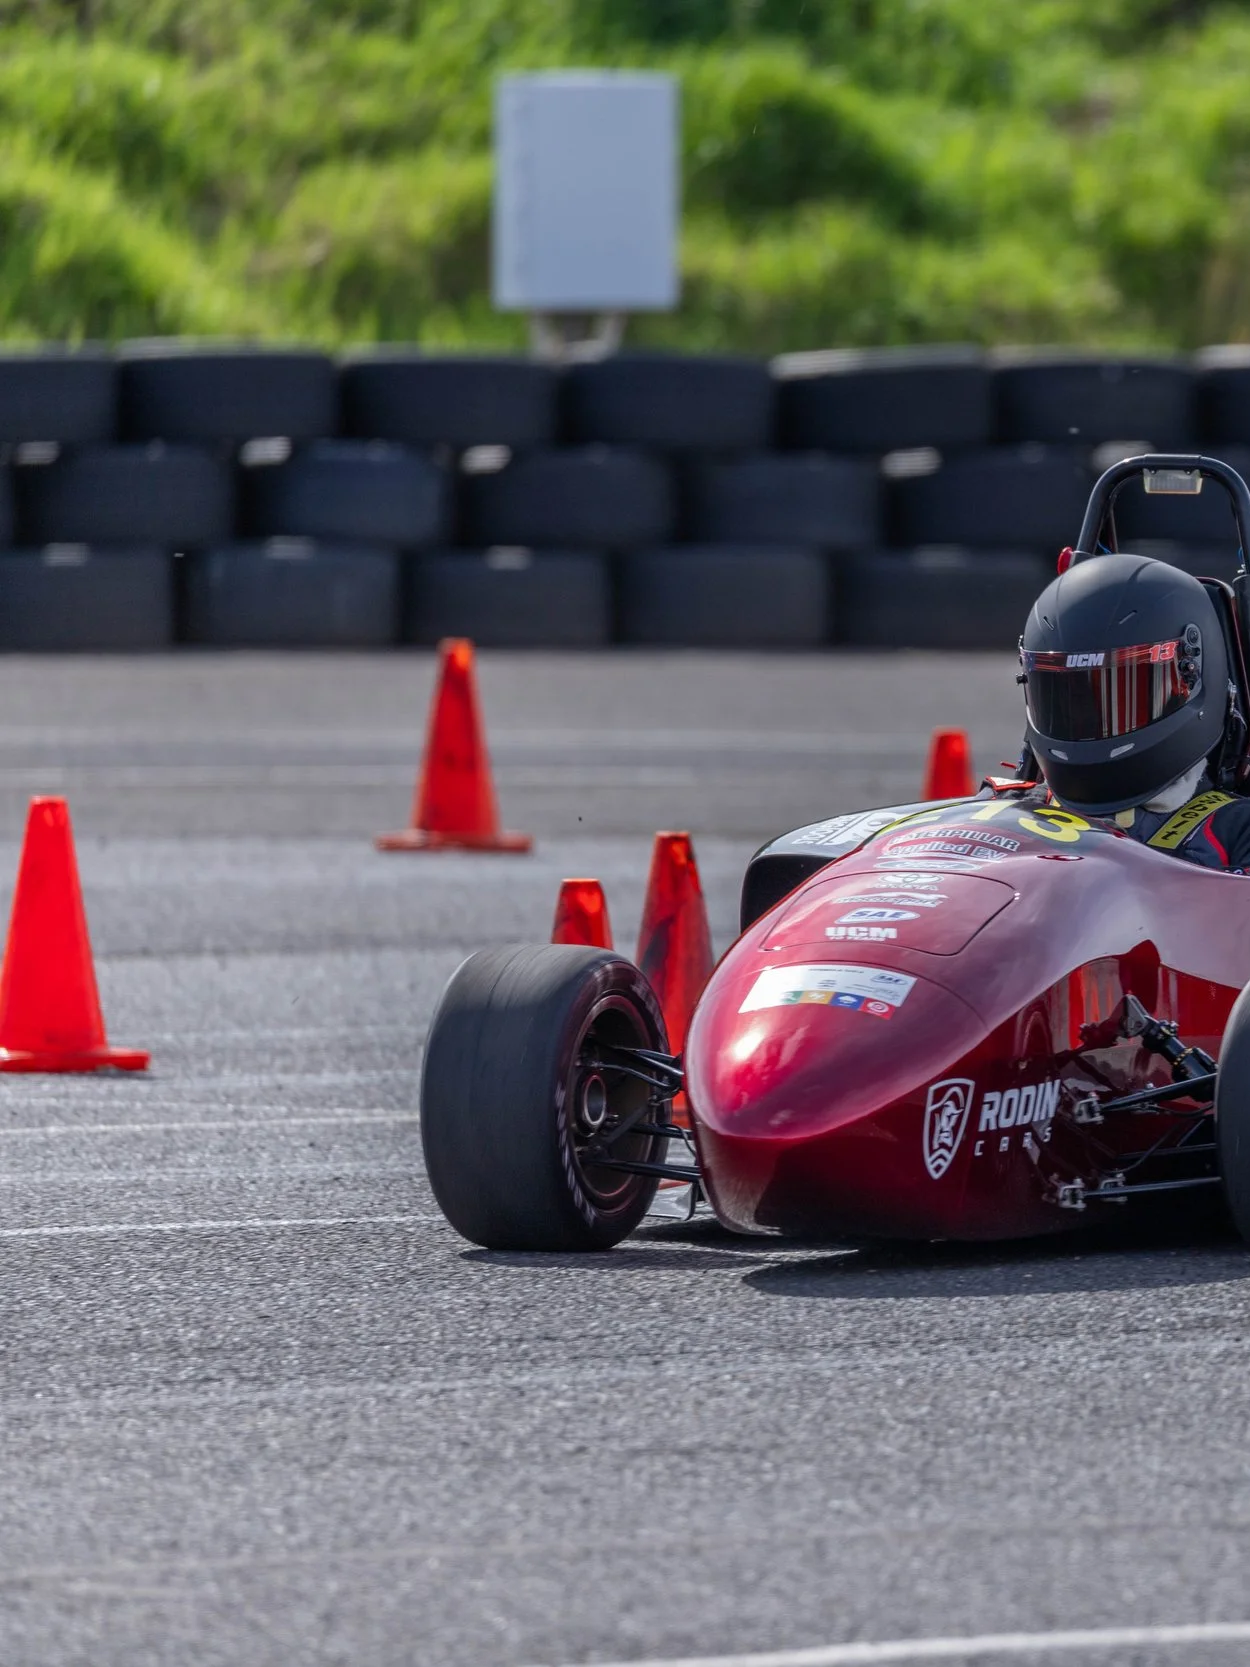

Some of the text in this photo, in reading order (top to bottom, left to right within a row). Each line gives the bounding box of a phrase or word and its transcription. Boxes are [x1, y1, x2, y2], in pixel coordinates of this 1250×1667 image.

[1065, 652, 1106, 668] UCM
[1150, 641, 1179, 663] 13
[850, 910, 907, 919] SAE
[825, 926, 898, 939] UCM
[977, 1079, 1062, 1132] RODIN
